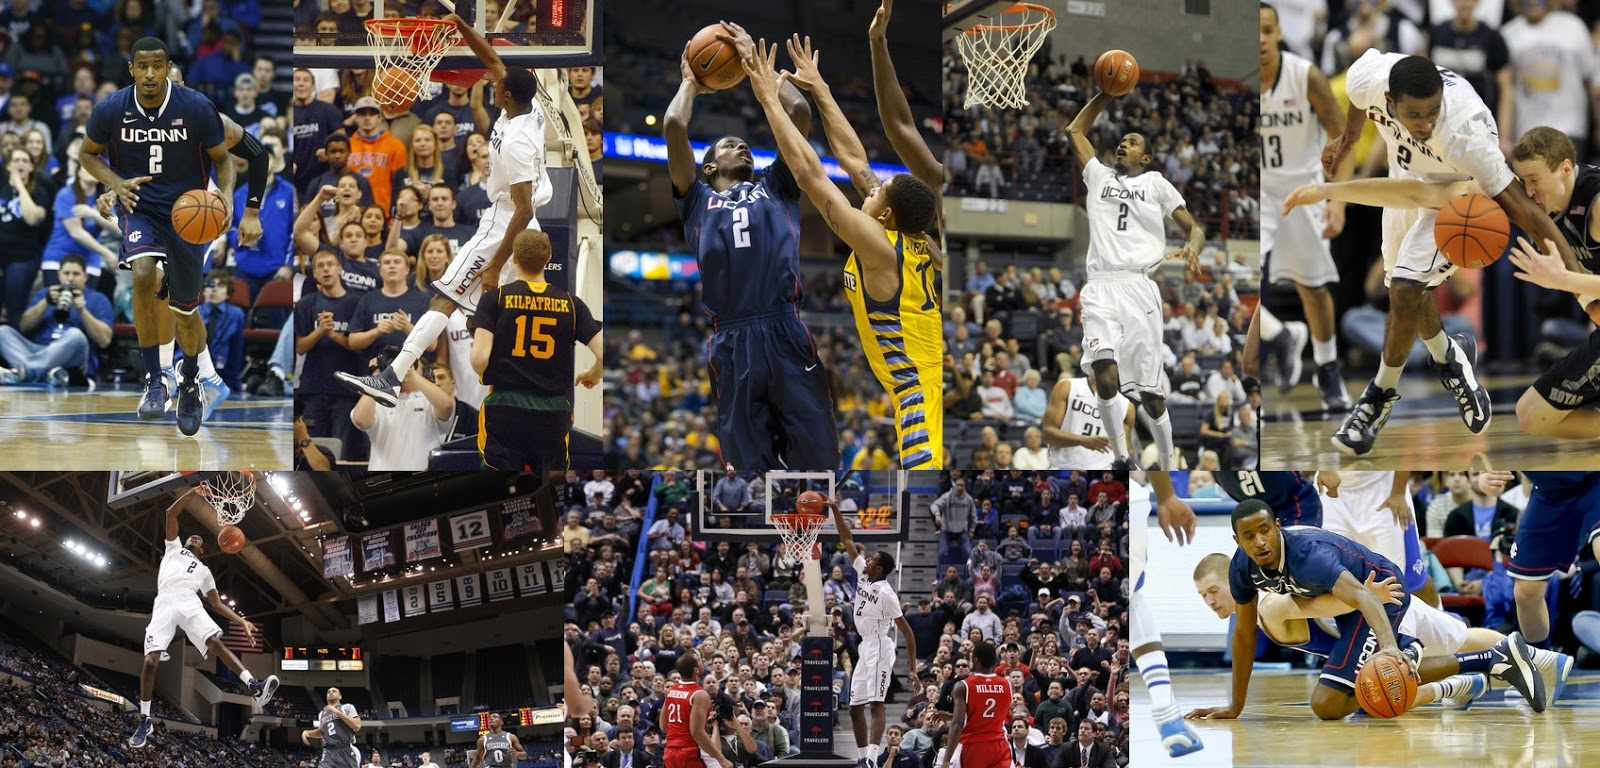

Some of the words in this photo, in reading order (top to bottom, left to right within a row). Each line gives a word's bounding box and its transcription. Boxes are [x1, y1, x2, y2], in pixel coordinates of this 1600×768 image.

[121, 127, 188, 143] UCONN
[149, 144, 163, 174] 2
[1396, 145, 1412, 171] 2
[1101, 186, 1145, 202] UCONN
[1117, 203, 1128, 231] 2
[732, 207, 752, 249] 2
[341, 270, 377, 288] UCONN
[455, 255, 486, 296] UCONN
[505, 295, 570, 313] KILPATRICK
[511, 314, 558, 360] 15
[457, 520, 484, 540] 12
[187, 561, 198, 574] 2
[491, 579, 508, 593] 10
[524, 573, 539, 587] 11
[436, 591, 446, 603] 5
[465, 585, 474, 598] 9
[856, 600, 866, 616] 2
[1380, 662, 1397, 680] THE
[975, 684, 1004, 694] MILLER
[535, 712, 561, 720] Premier
[668, 703, 682, 723] 21
[982, 698, 996, 718] 2
[327, 722, 337, 736] 2
[494, 750, 504, 763] 0
